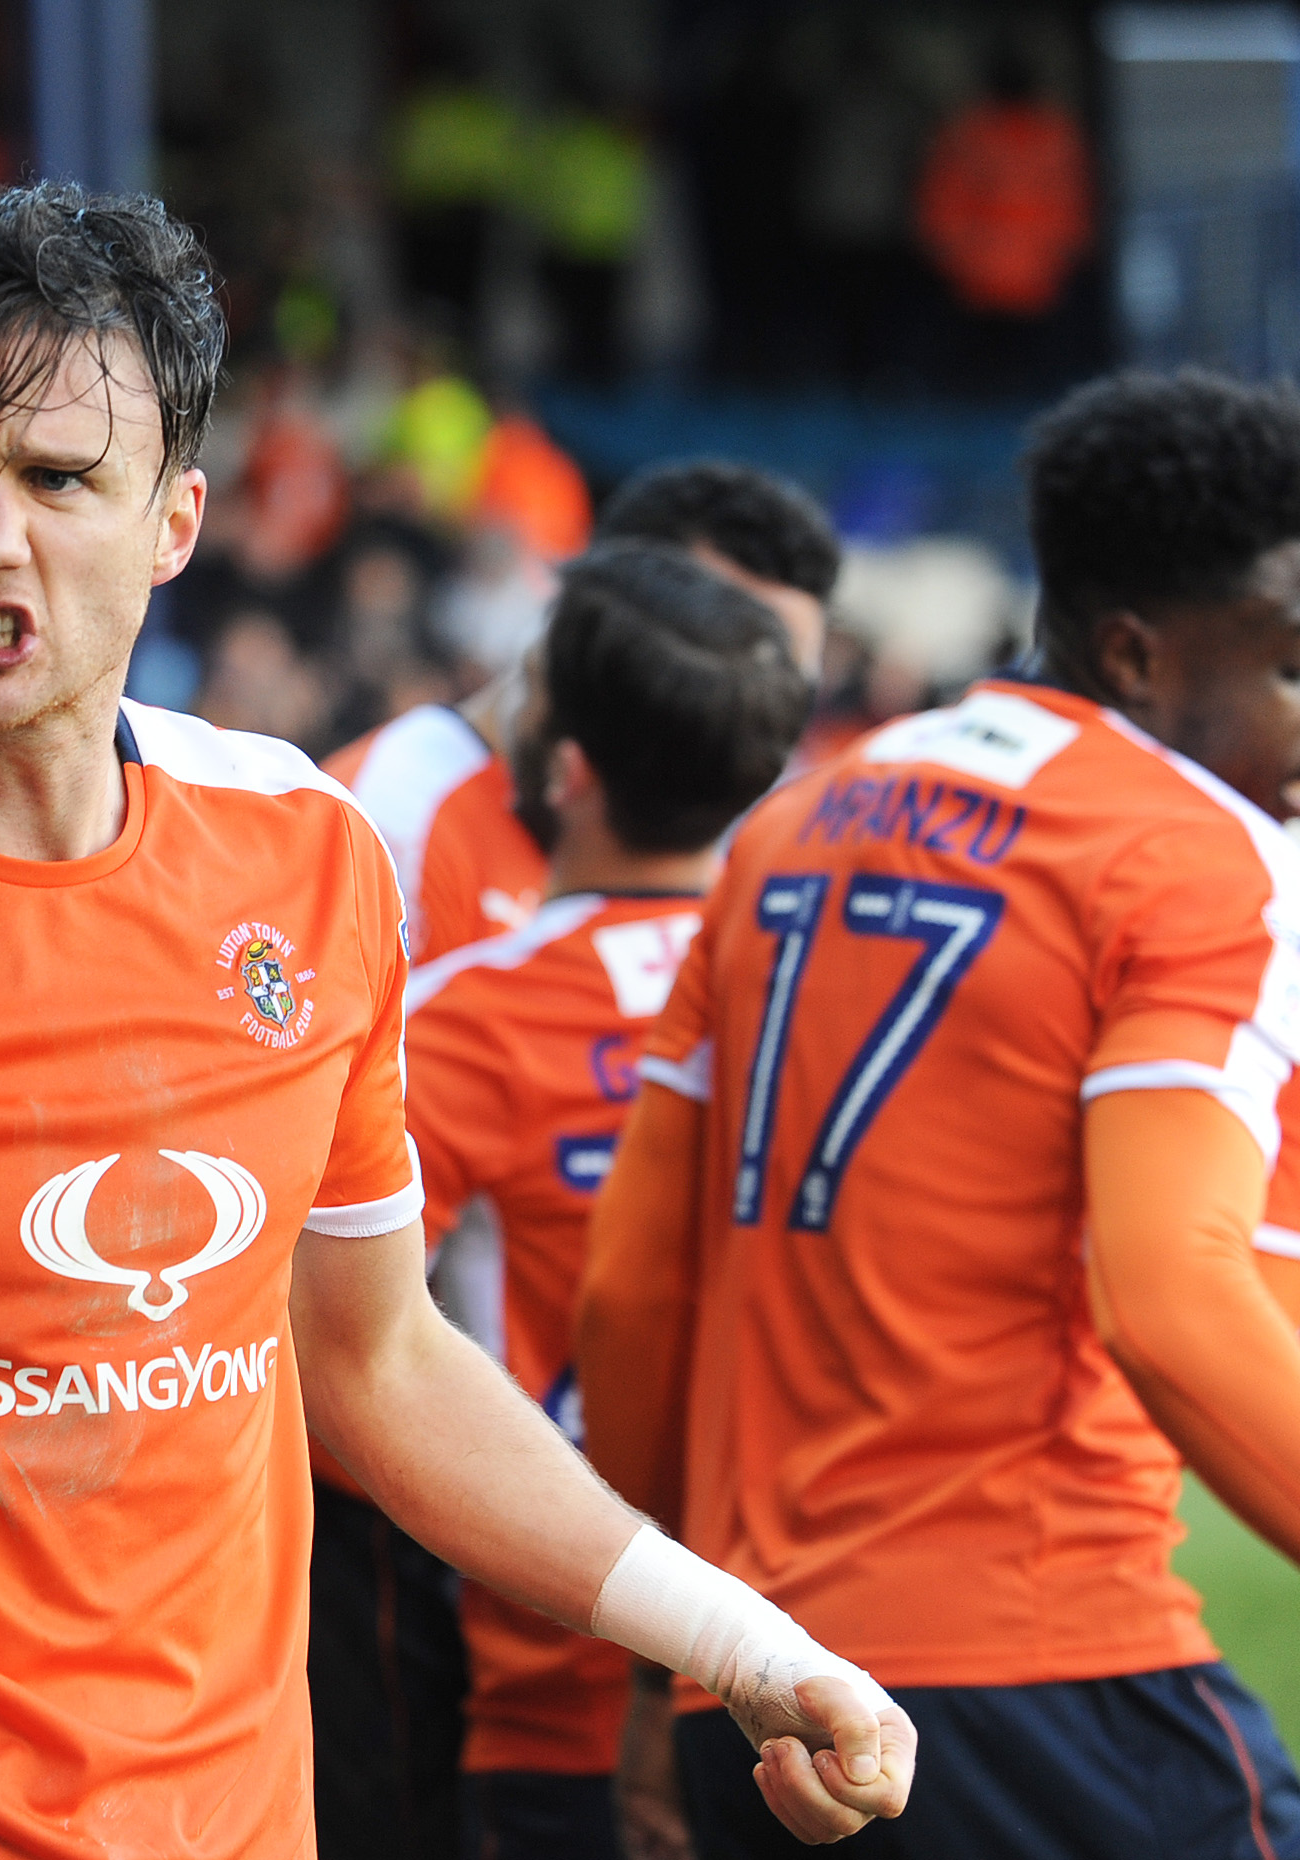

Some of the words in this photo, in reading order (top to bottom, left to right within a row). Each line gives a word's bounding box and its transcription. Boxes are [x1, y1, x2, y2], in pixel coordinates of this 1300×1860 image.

[799, 776, 1027, 866] MPANZU
[216, 922, 253, 970] LUTON
[251, 921, 296, 958] TOWN
[216, 986, 235, 1001] EST
[295, 968, 316, 983] 1885
[240, 1012, 298, 1049] FOOTBALL
[296, 998, 314, 1037] CLUB
[735, 871, 1006, 1234] 17
